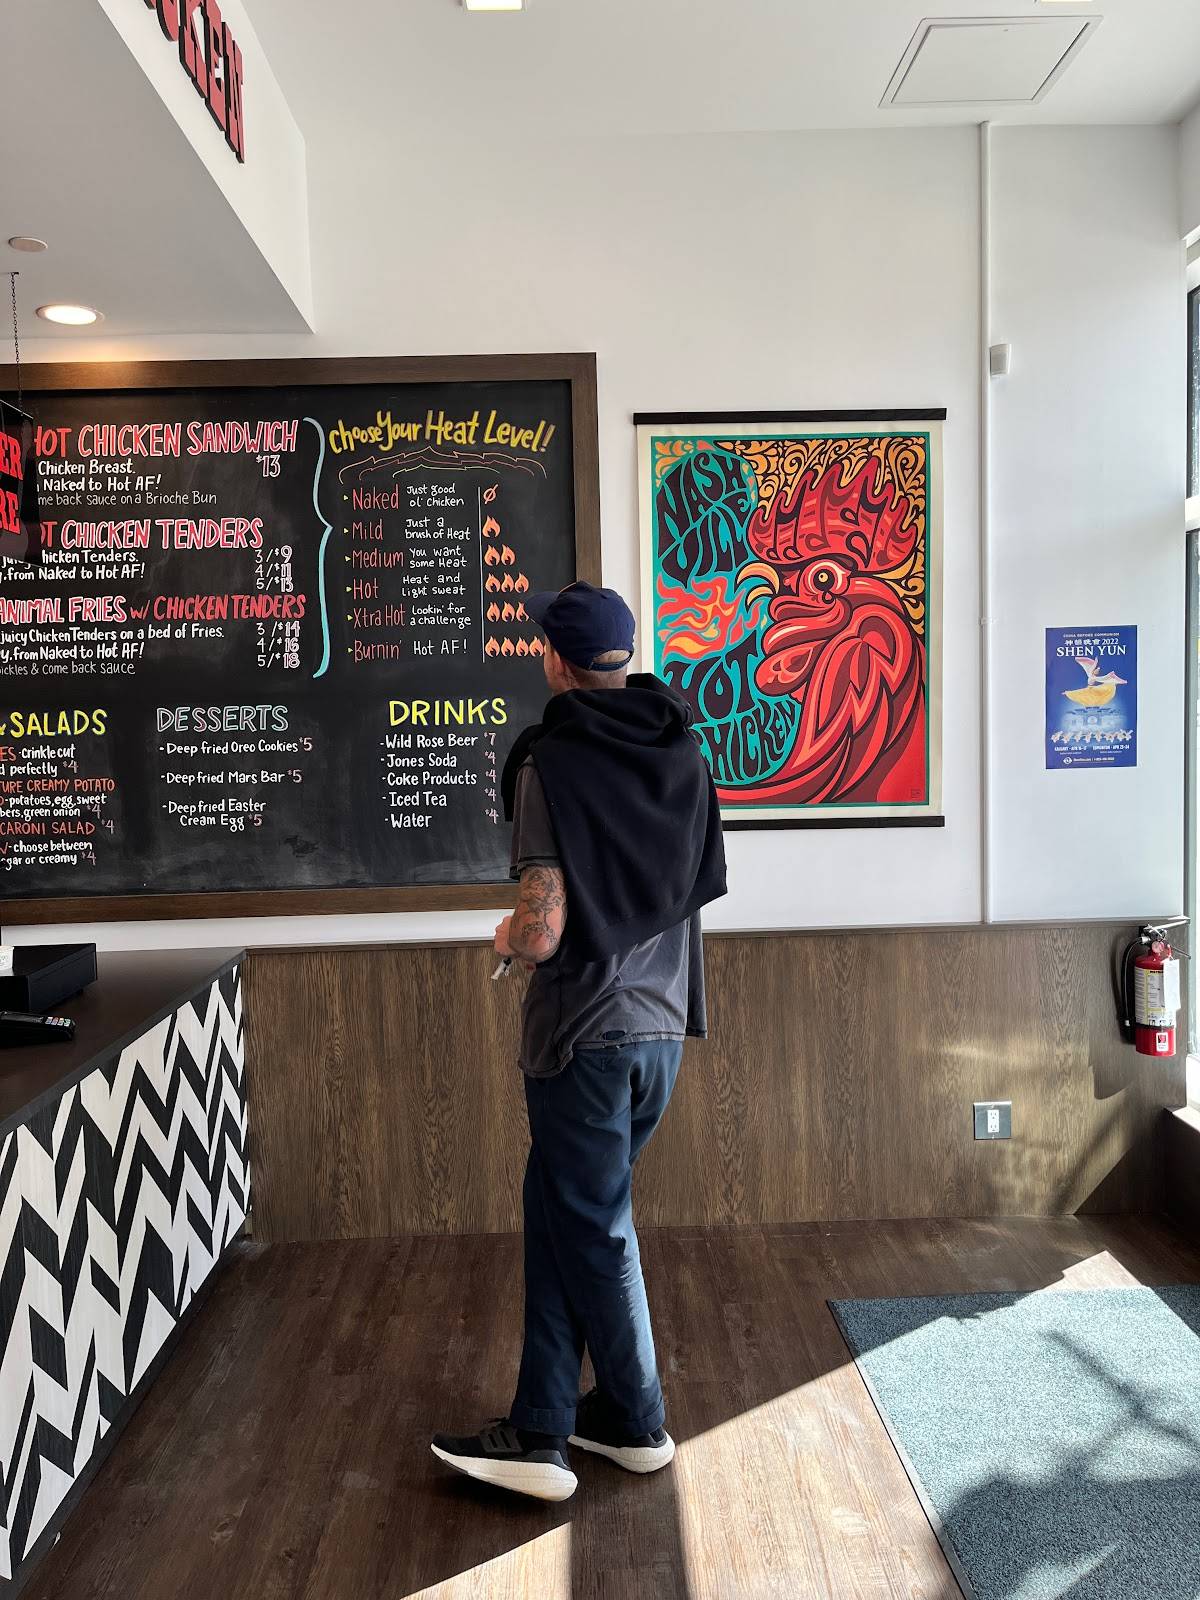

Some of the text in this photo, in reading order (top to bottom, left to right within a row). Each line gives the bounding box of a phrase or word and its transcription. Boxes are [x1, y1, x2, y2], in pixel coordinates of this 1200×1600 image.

[144, 0, 244, 163] KEN
[78, 423, 181, 457] CHICKEN
[187, 420, 298, 455] SANDWICH
[376, 410, 422, 450] Your
[425, 410, 479, 445] Heat
[483, 410, 556, 452] Level!
[38, 458, 136, 476] Chicken Breast.
[256, 454, 281, 477] $13
[43, 478, 85, 491] Naked
[88, 477, 102, 491] to
[107, 476, 132, 491] Hot
[135, 474, 162, 491] AF!
[406, 483, 456, 496] Just good
[56, 493, 82, 505] back
[86, 494, 117, 506] sauce
[121, 495, 133, 504] on
[146, 491, 189, 505] Brioche
[192, 490, 217, 505] Bun
[353, 484, 399, 510] Naked
[406, 517, 444, 528] Just a
[61, 518, 264, 549] CHICKEN TENDERS
[405, 527, 471, 541] brush of Heat
[42, 550, 79, 564] hicken
[81, 549, 139, 563] Tenders.
[352, 548, 403, 569] Medium
[433, 546, 461, 556] want
[409, 557, 468, 568] some Heat
[38, 566, 76, 579] Naked
[81, 566, 93, 578] to
[95, 565, 119, 579] Hot
[121, 562, 145, 578] AF!
[403, 572, 460, 584] Heat and
[353, 578, 379, 600] Hot
[432, 585, 466, 596] sweat
[0, 597, 64, 625] ANIMAL
[68, 596, 127, 622] FRIES
[153, 594, 228, 620] CHICKEN
[231, 594, 307, 619] TENDERS
[354, 603, 406, 629] Xtra Hot
[448, 603, 466, 614] for
[418, 615, 471, 629] challenge
[0, 623, 224, 646] juicy Chicken Tenders on a bed of Fries.
[1101, 637, 1119, 645] 2022
[40, 645, 77, 660] Naked
[80, 645, 93, 659] to
[96, 642, 119, 659] Hot
[122, 642, 145, 659] AF!
[414, 639, 434, 655] Hot
[1056, 645, 1127, 657] SHEN YUN
[31, 662, 39, 675] &
[42, 663, 68, 675] come
[71, 661, 97, 674] back
[100, 662, 136, 675] sauce
[157, 705, 289, 732] DESSERTS
[389, 697, 508, 726] DRINKS
[10, 709, 108, 738] SALADS
[200, 741, 228, 754] fried
[231, 741, 256, 752] Oreo
[258, 739, 299, 752] Cookies
[417, 735, 444, 748] Rose
[448, 734, 478, 747] Beer
[689, 699, 796, 781] HICKEN
[58, 743, 76, 758] cut
[428, 753, 457, 767] Soda
[10, 762, 58, 777] perfectly
[197, 771, 224, 783] fried
[228, 771, 258, 784] Mars
[260, 770, 285, 783] Bar
[422, 770, 477, 785] Products
[0, 779, 116, 793] URE CREAMY POTATO
[198, 799, 225, 812] fried
[228, 798, 267, 812] Easter
[423, 791, 447, 807] Tea
[53, 807, 80, 817] onion
[0, 821, 96, 835] CARONI SALAD
[180, 815, 216, 826] Cream
[221, 814, 244, 832] Egg
[50, 839, 93, 851] between
[25, 856, 36, 865] or
[38, 853, 78, 866] creamy
